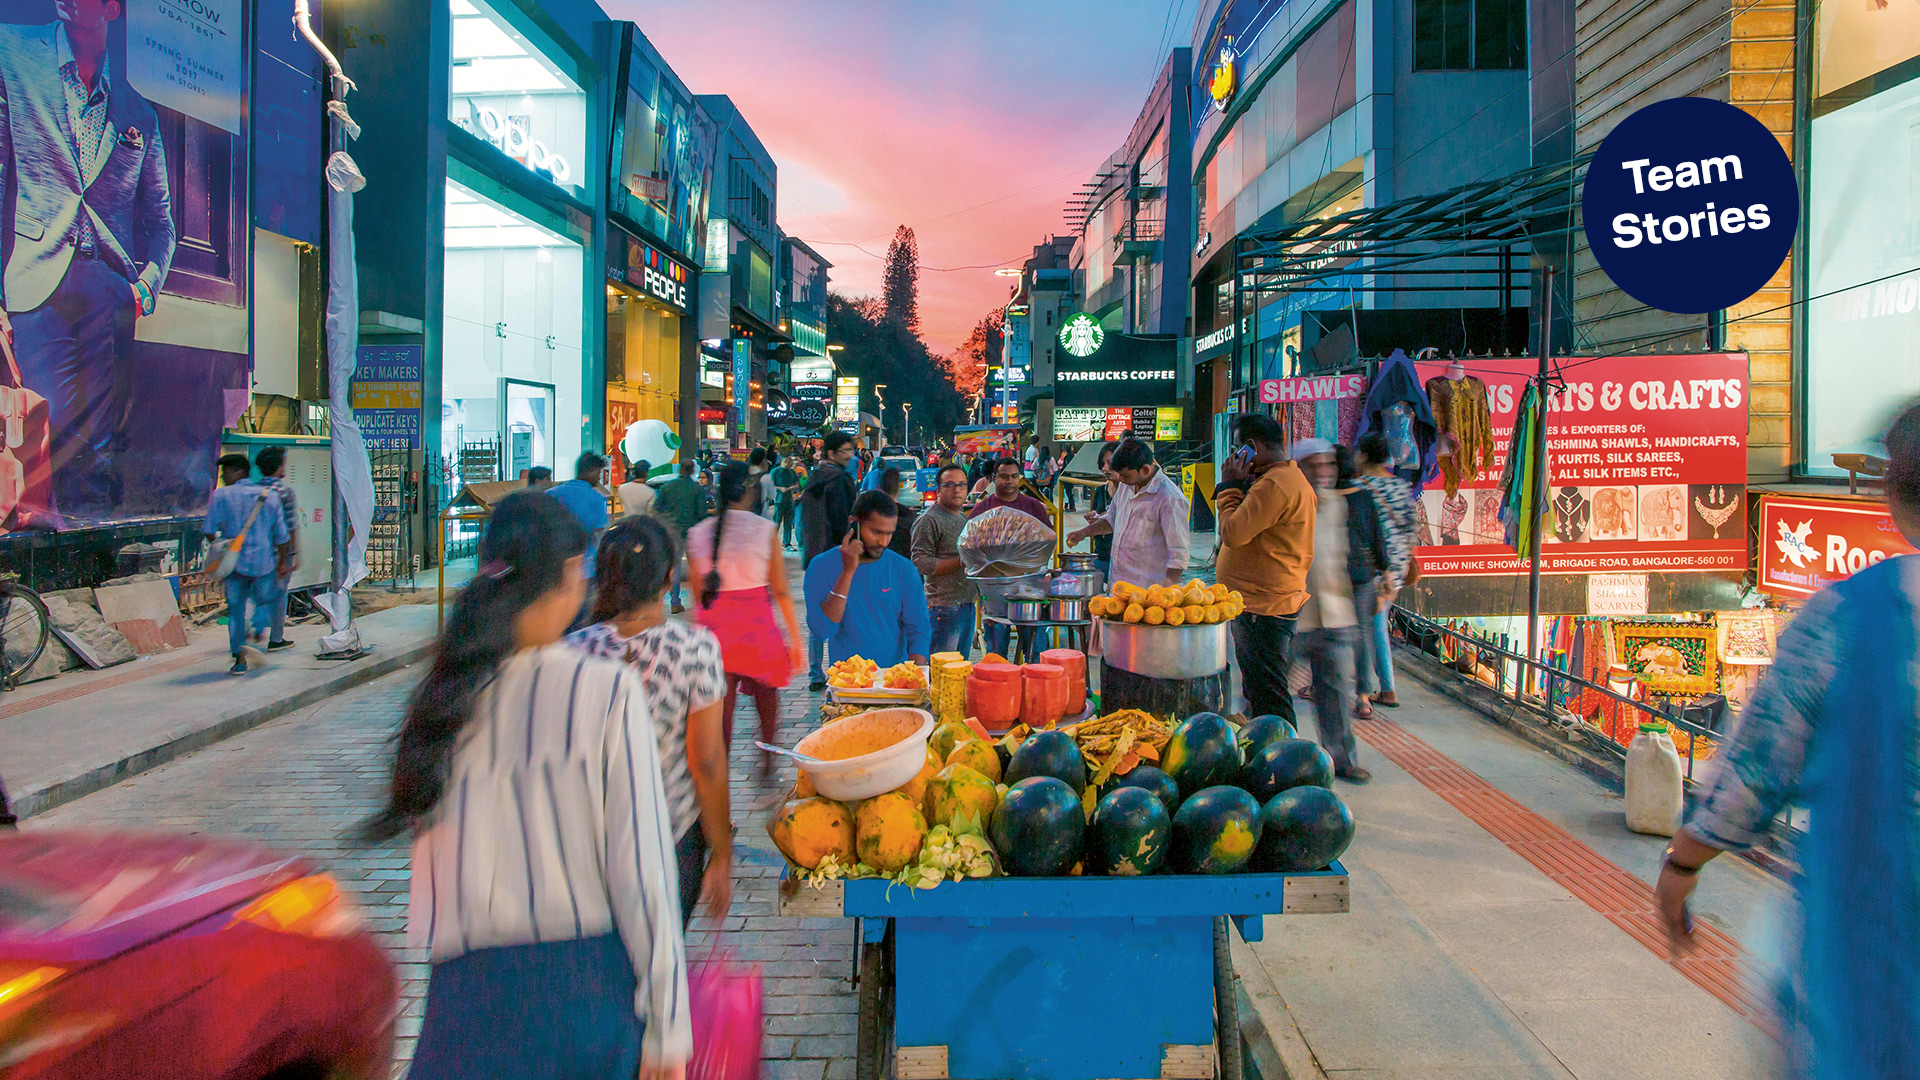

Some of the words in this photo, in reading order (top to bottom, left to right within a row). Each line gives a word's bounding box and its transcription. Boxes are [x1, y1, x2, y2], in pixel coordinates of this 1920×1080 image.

[145, 37, 182, 61] SPRING
[186, 57, 224, 81] SUMMER
[176, 63, 198, 80] 2017
[166, 72, 175, 81] IN
[178, 78, 206, 95] STORES
[479, 106, 570, 182] oppo
[644, 266, 687, 309] PEOPLE
[1196, 328, 1225, 354] STARBUCKS
[356, 366, 377, 379] KEY
[378, 366, 418, 379] MAKERS
[994, 373, 1026, 381] PARIKA
[1057, 371, 1129, 381] STARBUCKS
[1130, 370, 1176, 380] COFFEE
[355, 383, 366, 391] TAJ
[368, 383, 397, 391] NUMBER
[398, 383, 420, 391] PLATE
[791, 388, 833, 397] BLOSSOMS
[1263, 376, 1362, 402] SHAWLS
[1546, 381, 1594, 413] RTS
[1600, 380, 1623, 411] &
[1629, 378, 1742, 410] CRAFTS
[356, 414, 395, 428] DUPLICATE
[396, 414, 418, 428] KEY'S
[611, 405, 636, 434] SALE
[1054, 408, 1107, 420] TATTOO
[1561, 426, 1569, 435] &
[1571, 425, 1628, 435] EXPORTERS
[1630, 424, 1646, 433] OF:
[1547, 437, 1599, 450] ASHMINA
[1601, 437, 1653, 450] SHAWLS,
[1655, 436, 1741, 448] HANDICRAFTS,
[1557, 453, 1604, 466] KURTIS,
[1606, 453, 1636, 465] SILK
[1636, 452, 1684, 465] SAREES,
[1559, 470, 1579, 479] ALL
[1579, 470, 1610, 479] SILK
[1612, 469, 1648, 479] ITEMS
[1650, 468, 1680, 479] ETC.,
[1783, 532, 1806, 553] RAC
[1424, 561, 1460, 571] BELOW
[1461, 560, 1485, 570] NIKE
[1552, 558, 1598, 568] BRIGADE
[1599, 557, 1631, 568] ROAD,
[1632, 556, 1716, 567] BANGALORE-560
[1717, 556, 1735, 565] 001
[1591, 577, 1643, 587] PASHMINA
[1770, 567, 1808, 585] Manufacturers
[1809, 573, 1814, 586] &
[1593, 601, 1644, 611] SCARVES
